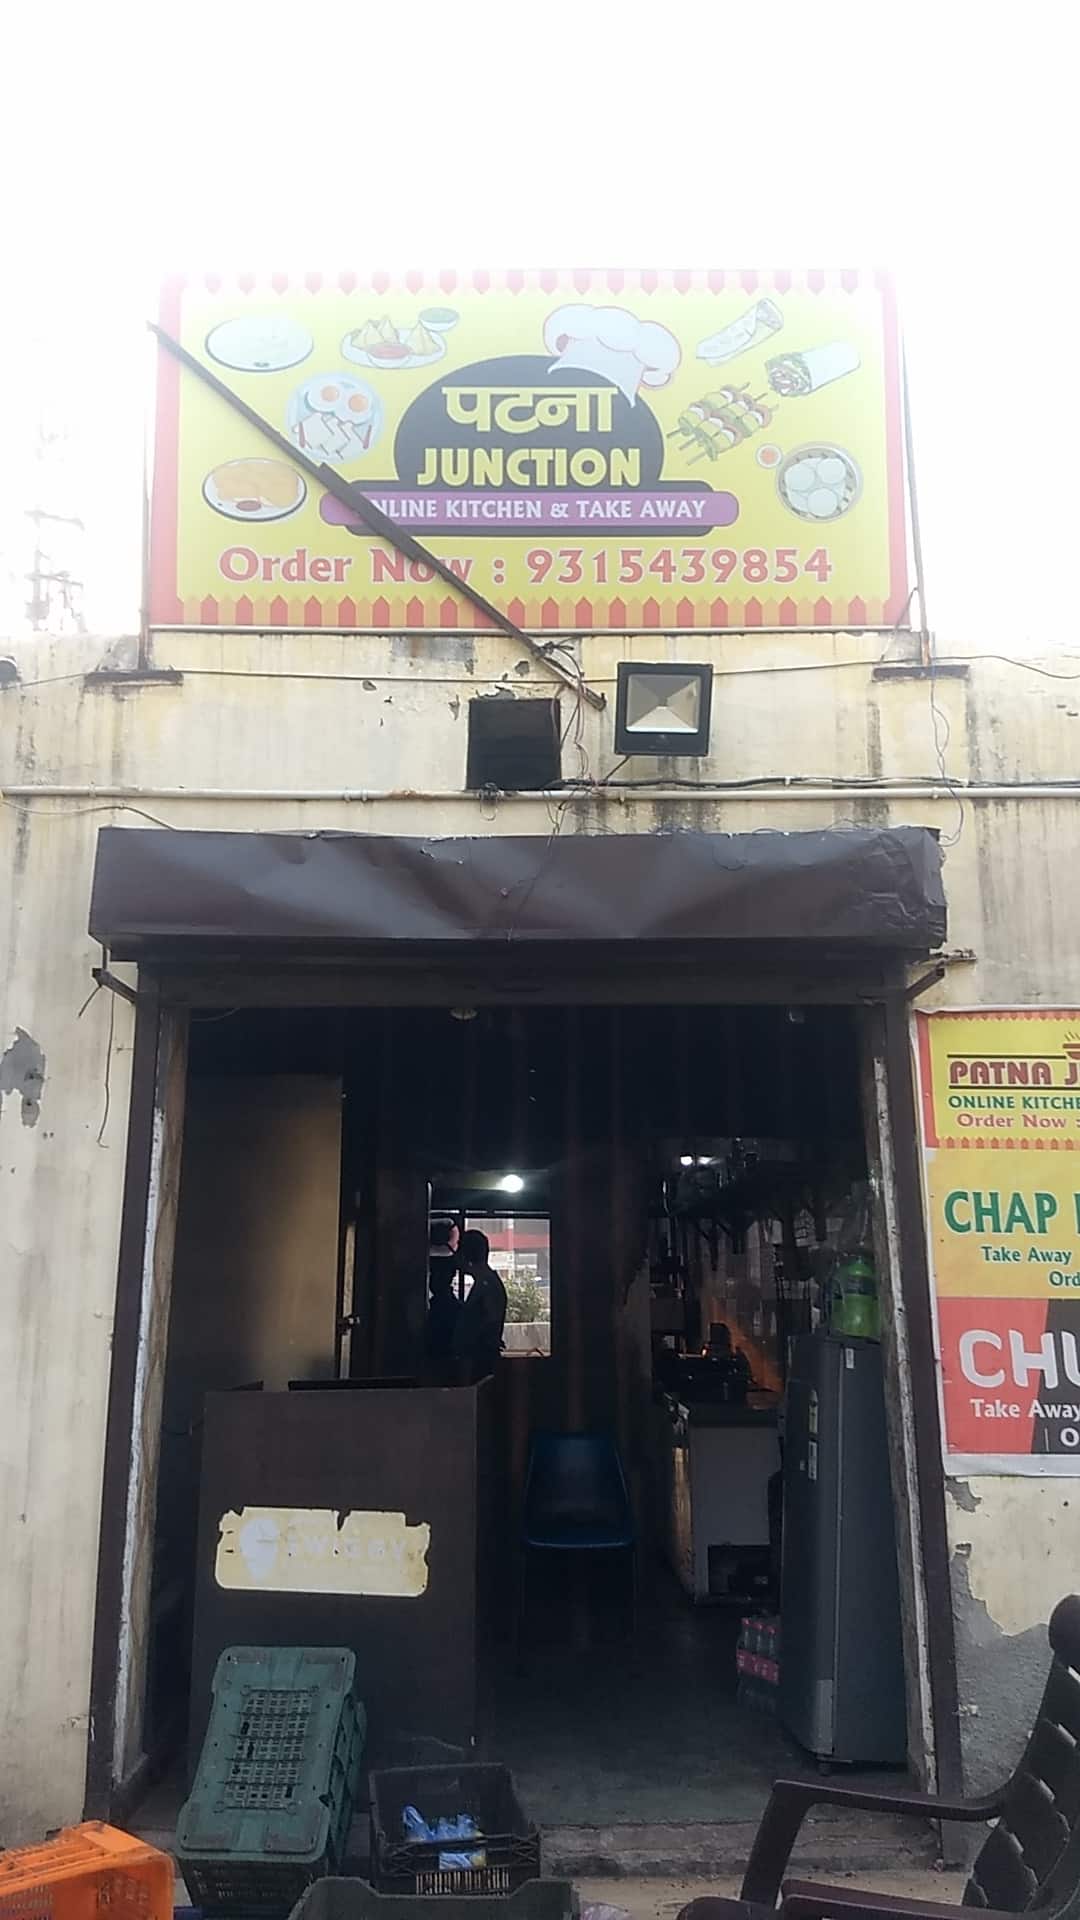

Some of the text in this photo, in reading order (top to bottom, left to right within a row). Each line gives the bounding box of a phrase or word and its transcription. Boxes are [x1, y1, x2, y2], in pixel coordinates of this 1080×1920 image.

[441, 386, 619, 434] पटना
[417, 447, 641, 486] JUNCTION
[370, 499, 706, 518] NLINE KITCHEN & TAKE AWAY
[219, 547, 352, 582] Order
[493, 559, 505, 584] :
[527, 549, 832, 584] 9315439854
[950, 1061, 1052, 1085] PATNA
[948, 1096, 1015, 1109] ONLINE
[957, 1113, 1014, 1128] Order
[1022, 1114, 1066, 1128] Now
[944, 1191, 1057, 1234] CHAP
[982, 1247, 1072, 1265] Take Away
[970, 1399, 1021, 1418] Take
